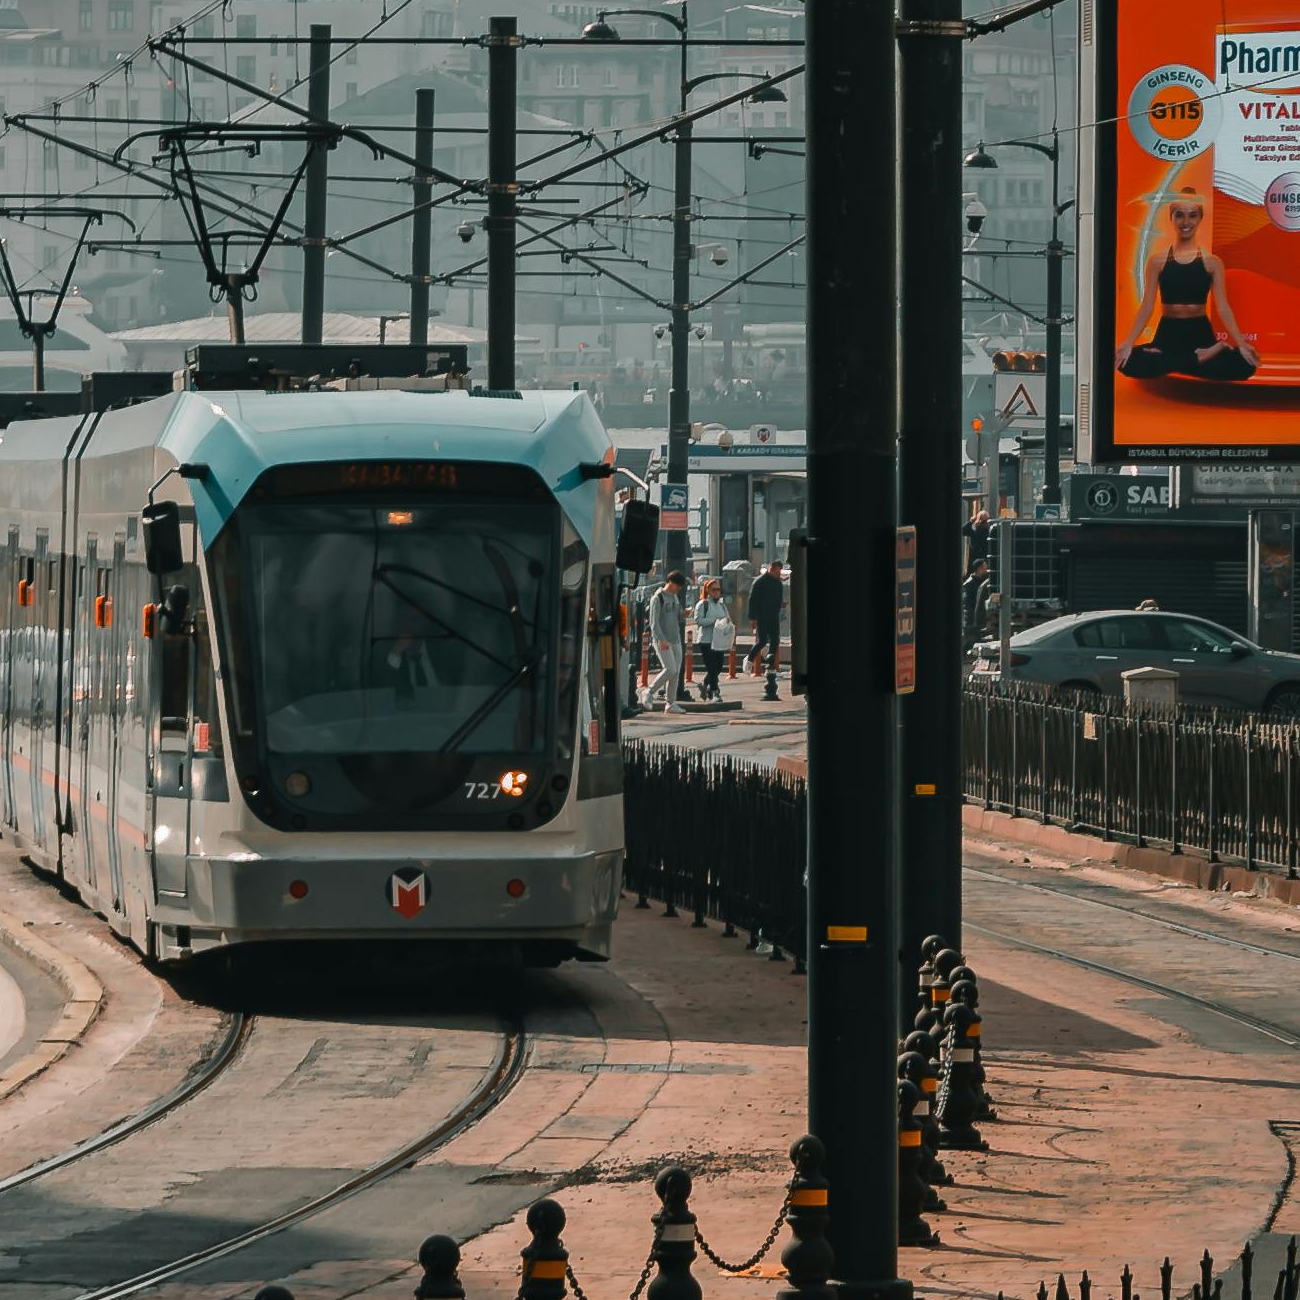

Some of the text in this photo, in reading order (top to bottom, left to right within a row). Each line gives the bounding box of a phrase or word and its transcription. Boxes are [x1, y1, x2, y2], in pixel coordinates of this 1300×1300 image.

[1147, 71, 1205, 89] GINSENG
[1150, 102, 1200, 120] G115
[1238, 102, 1300, 120] VITAL
[1153, 138, 1200, 156] İÇERİR
